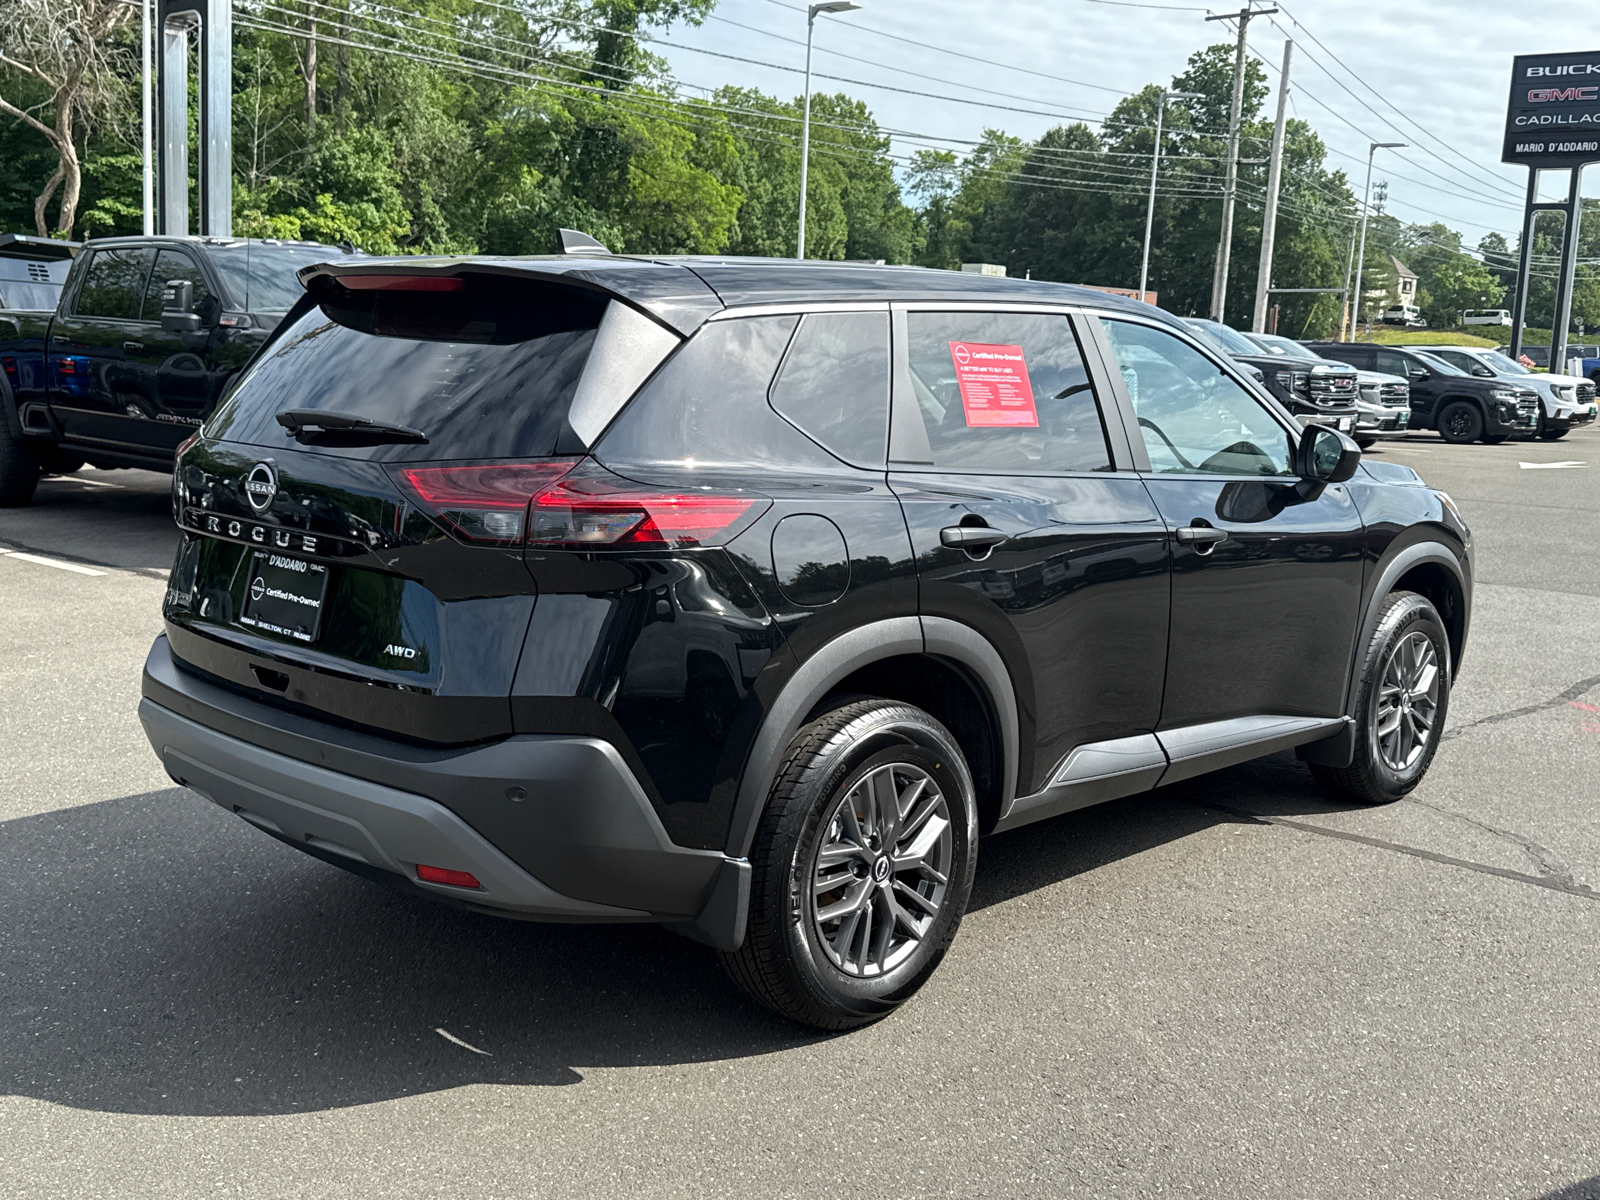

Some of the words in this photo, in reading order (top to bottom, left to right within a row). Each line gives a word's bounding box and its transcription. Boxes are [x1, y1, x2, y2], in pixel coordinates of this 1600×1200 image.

[1526, 64, 1600, 77] BUICK
[1528, 86, 1599, 103] GMC
[1516, 143, 1544, 153] MARIO
[1548, 141, 1598, 152] D'ADDARIO
[972, 351, 994, 359] Certified
[246, 481, 275, 494] NSSAN
[207, 515, 318, 553] ROGUE
[269, 554, 307, 573] D'ADDARIO
[310, 563, 325, 572] GMC
[266, 587, 288, 600] Certified
[383, 643, 416, 659] AWD
[816, 763, 847, 808] TOURING
